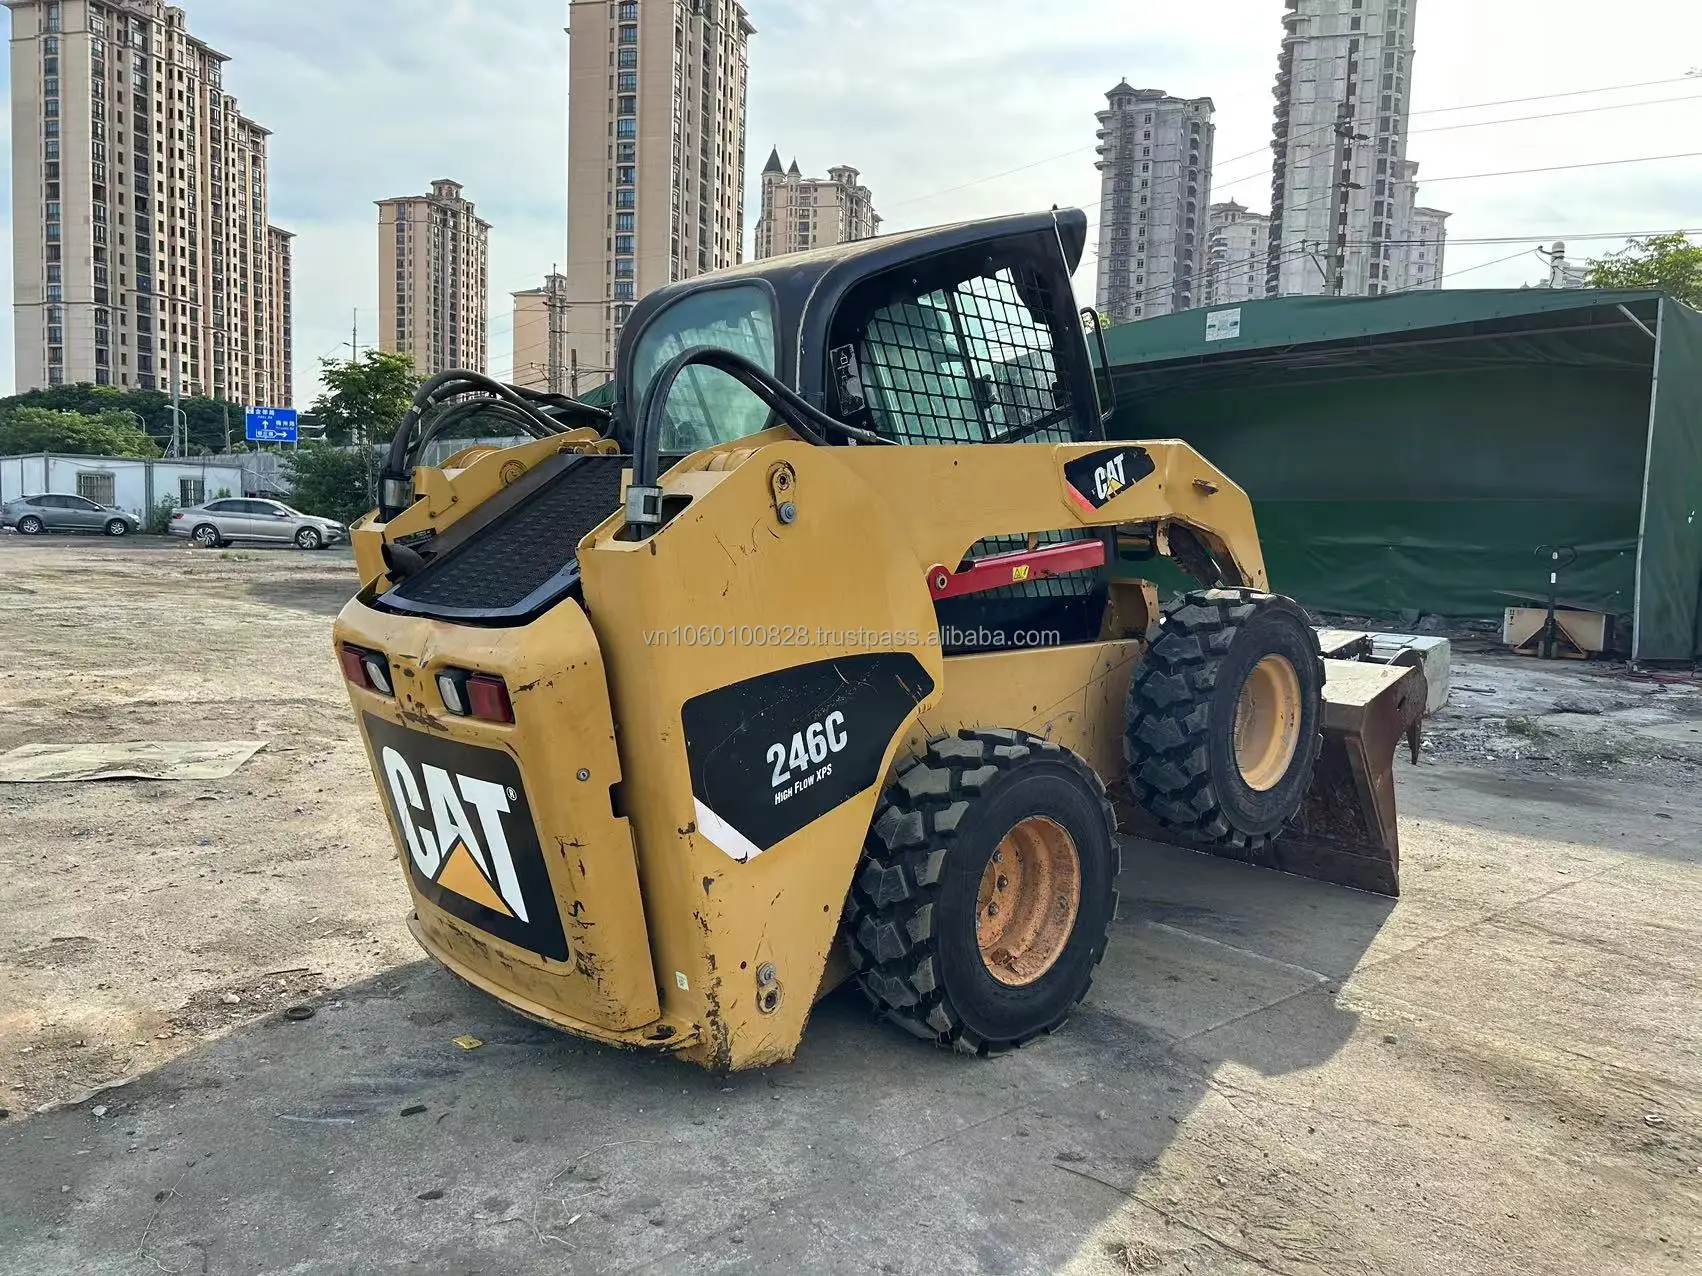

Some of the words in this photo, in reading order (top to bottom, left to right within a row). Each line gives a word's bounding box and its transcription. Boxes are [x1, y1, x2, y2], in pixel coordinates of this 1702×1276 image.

[1094, 453, 1126, 500] CAT
[766, 710, 848, 788] 246C
[816, 763, 833, 782] XPS
[382, 746, 530, 923] CAT
